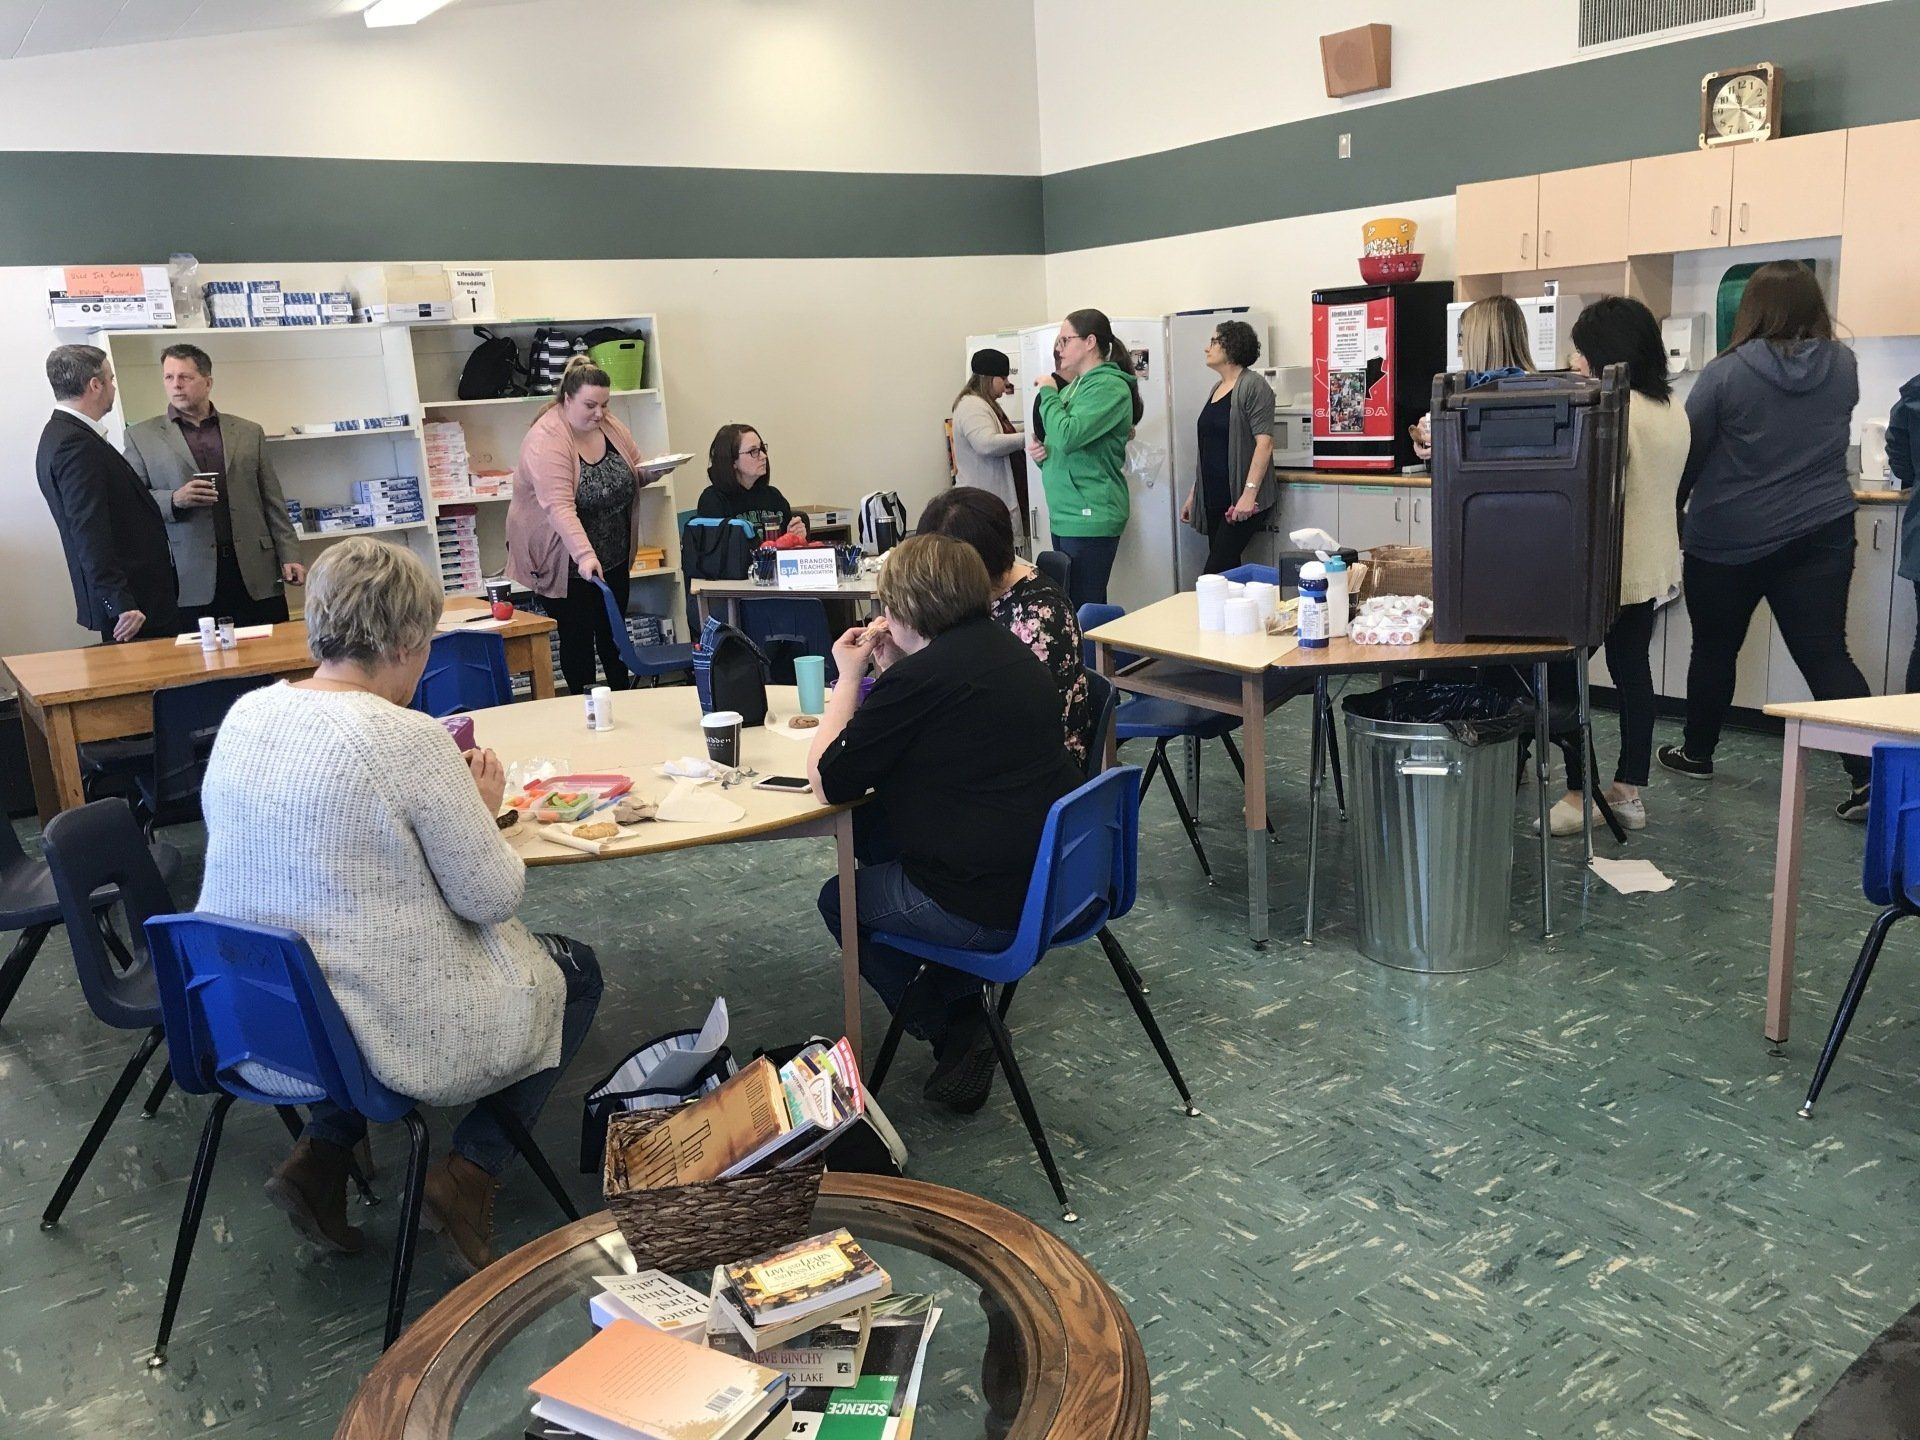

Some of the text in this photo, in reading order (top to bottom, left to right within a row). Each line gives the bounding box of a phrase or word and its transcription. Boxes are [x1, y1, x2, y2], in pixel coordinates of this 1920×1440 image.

[799, 557, 833, 565] BRANDON
[781, 566, 798, 575] BTA
[681, 1118, 711, 1169] The
[765, 1267, 786, 1278] LIVE
[799, 1253, 832, 1266] LEARN
[626, 1286, 686, 1303] Think
[655, 1303, 709, 1322] Dance
[780, 1352, 824, 1365] BINCHY
[800, 1372, 824, 1383] LAKE
[827, 1402, 889, 1416] SCIENCE
